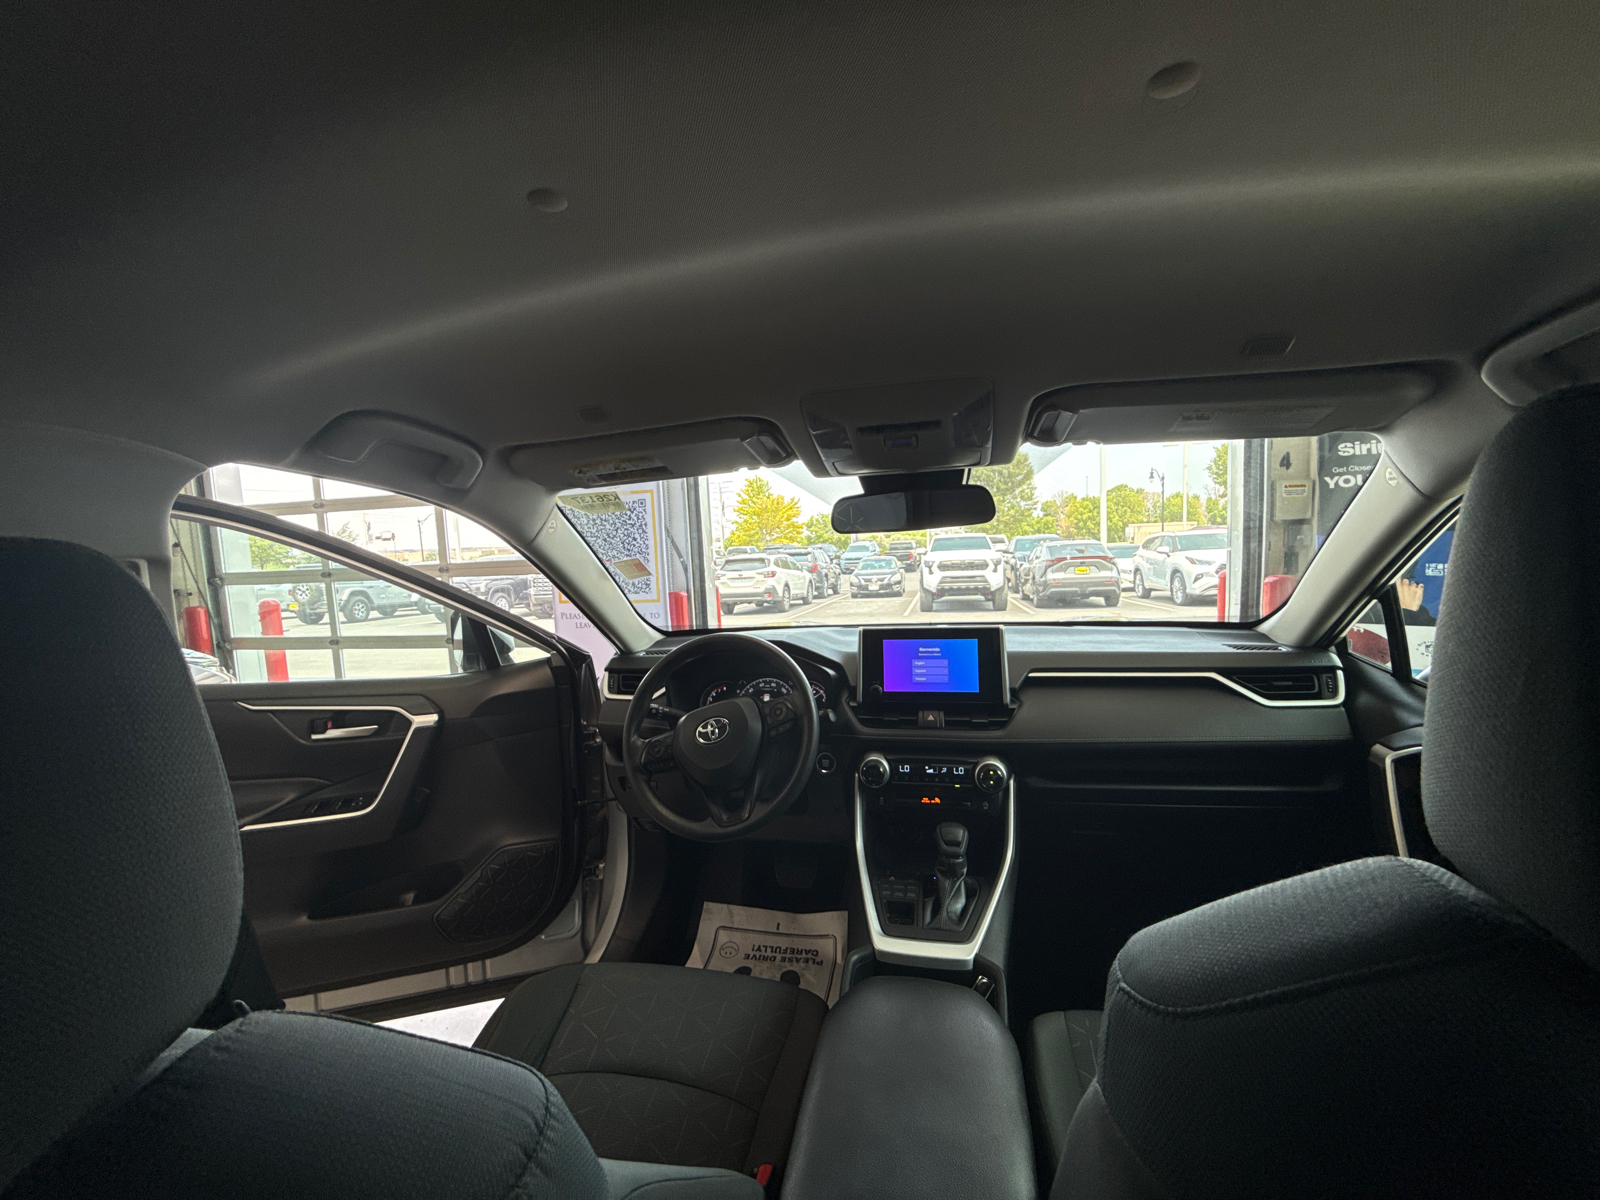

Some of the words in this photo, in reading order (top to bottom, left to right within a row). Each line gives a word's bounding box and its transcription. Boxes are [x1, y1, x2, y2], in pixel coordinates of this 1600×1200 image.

[1279, 451, 1292, 470] 4
[751, 944, 819, 957] CAREFULLY!
[743, 953, 777, 962] DRIVE
[780, 956, 824, 966] PLEASE
